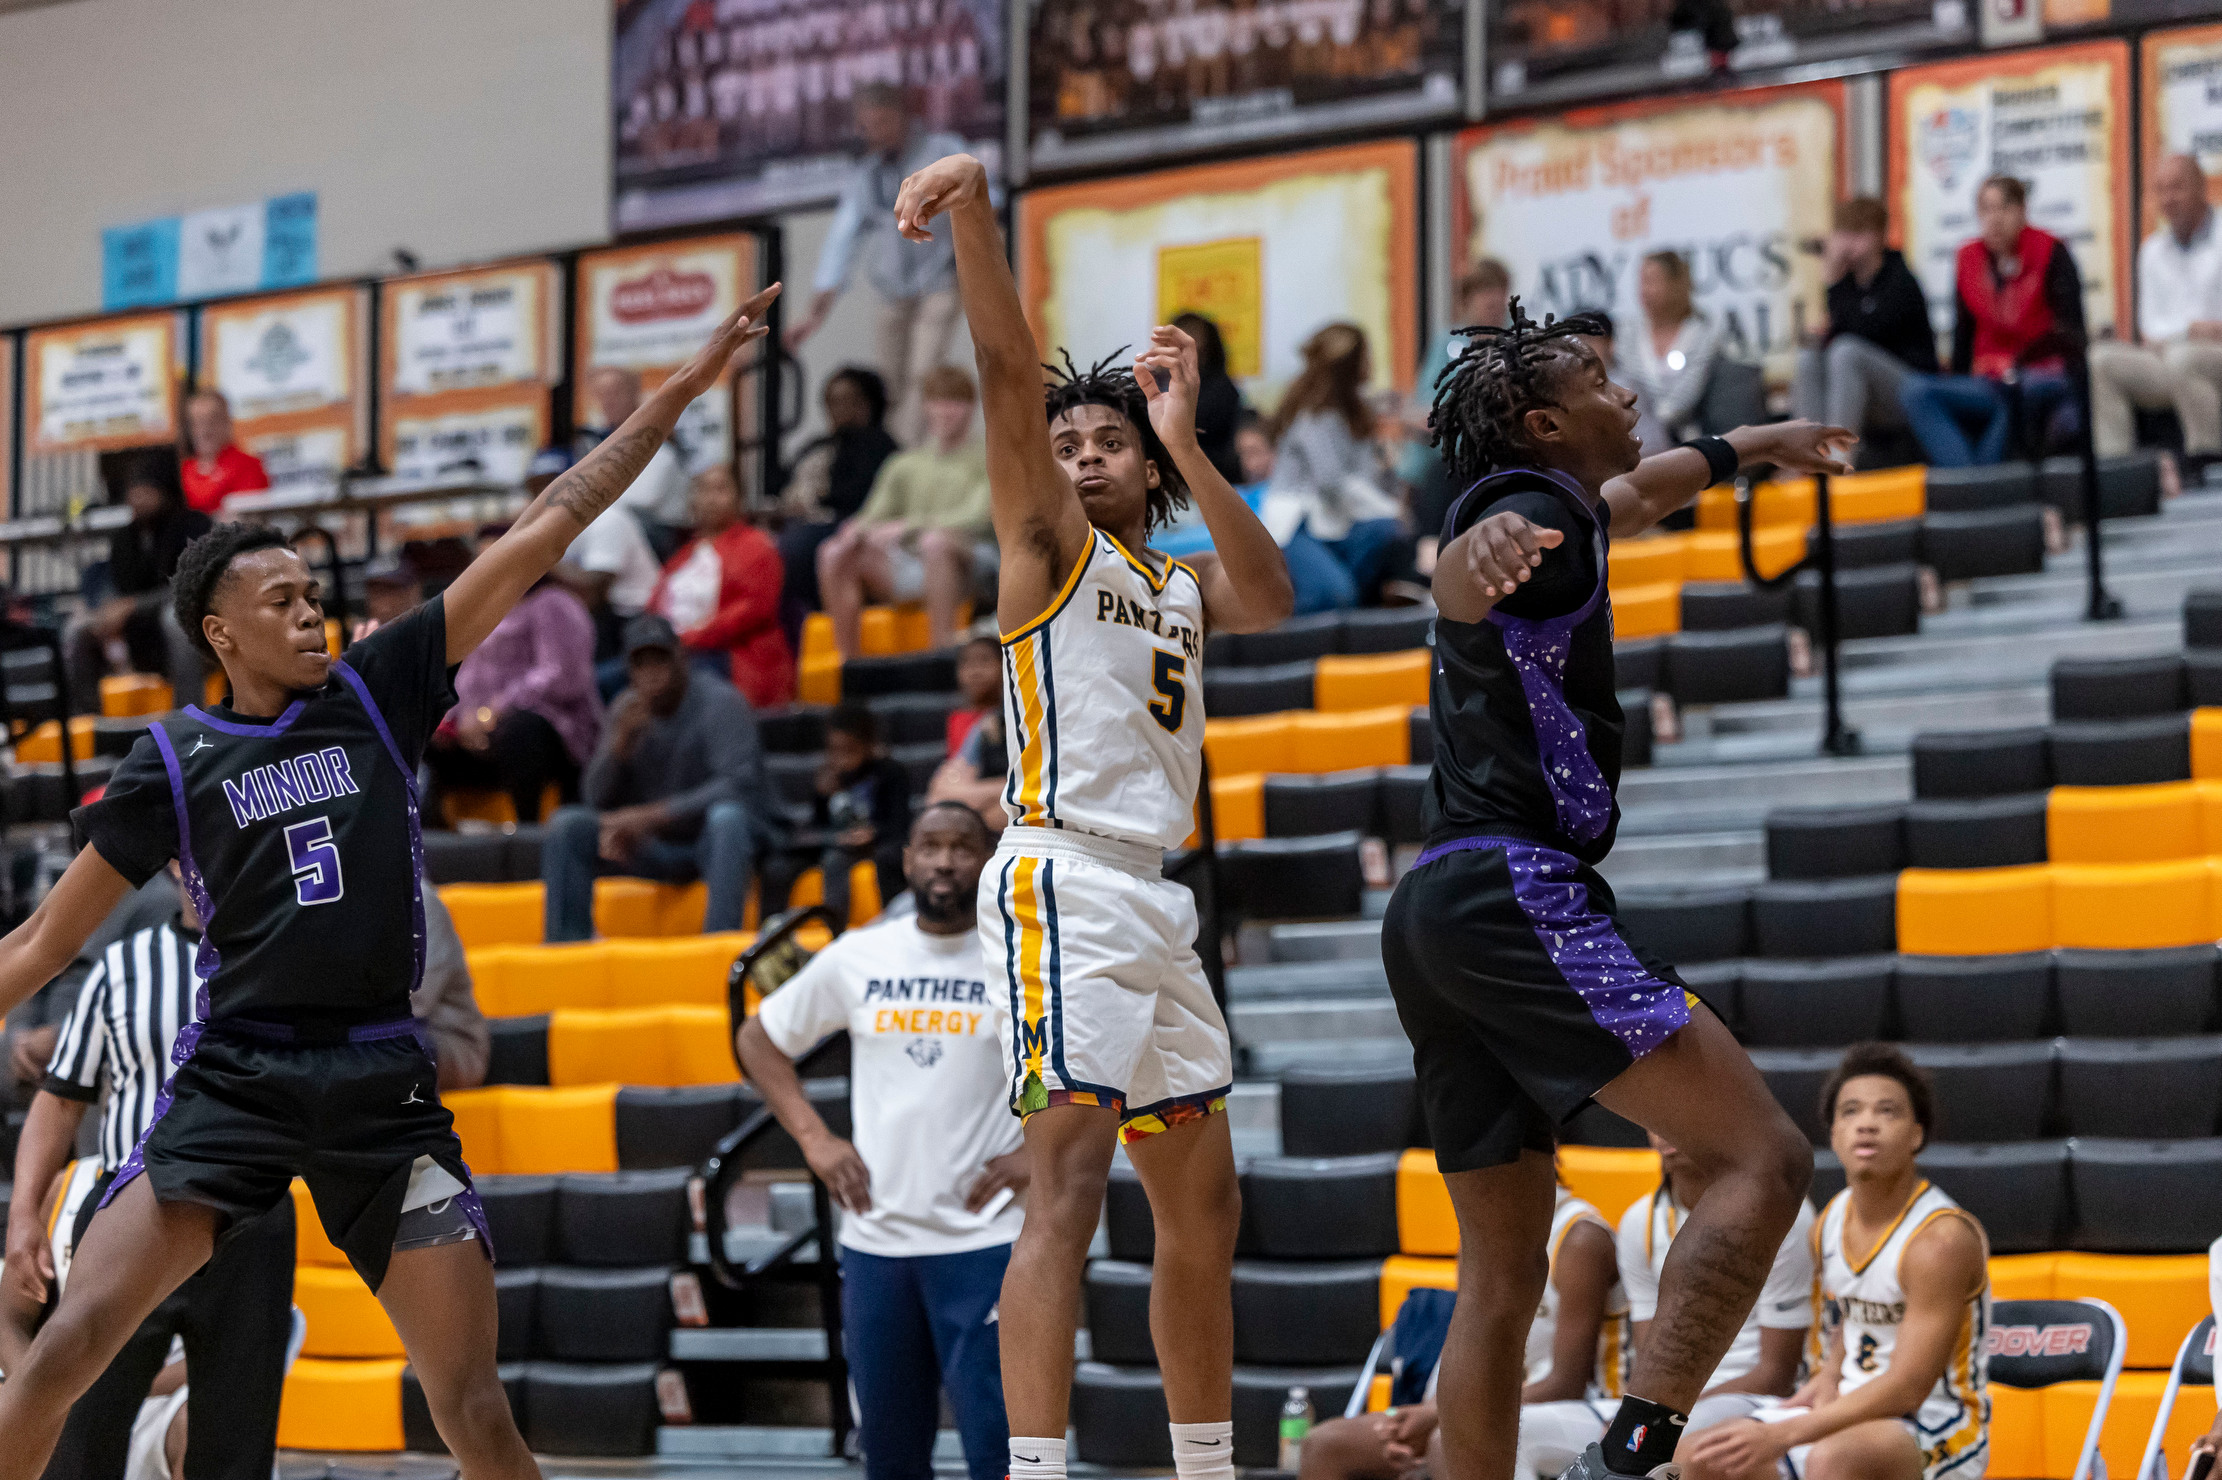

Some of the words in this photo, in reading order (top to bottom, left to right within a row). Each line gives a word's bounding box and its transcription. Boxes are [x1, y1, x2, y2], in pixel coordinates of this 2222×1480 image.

[1147, 646, 1187, 735] 5
[222, 746, 360, 829] MINOR
[283, 815, 344, 906] 5
[864, 978, 991, 1005] PANTHER
[874, 1008, 983, 1036] ENERGY
[1022, 1016, 1049, 1060] M
